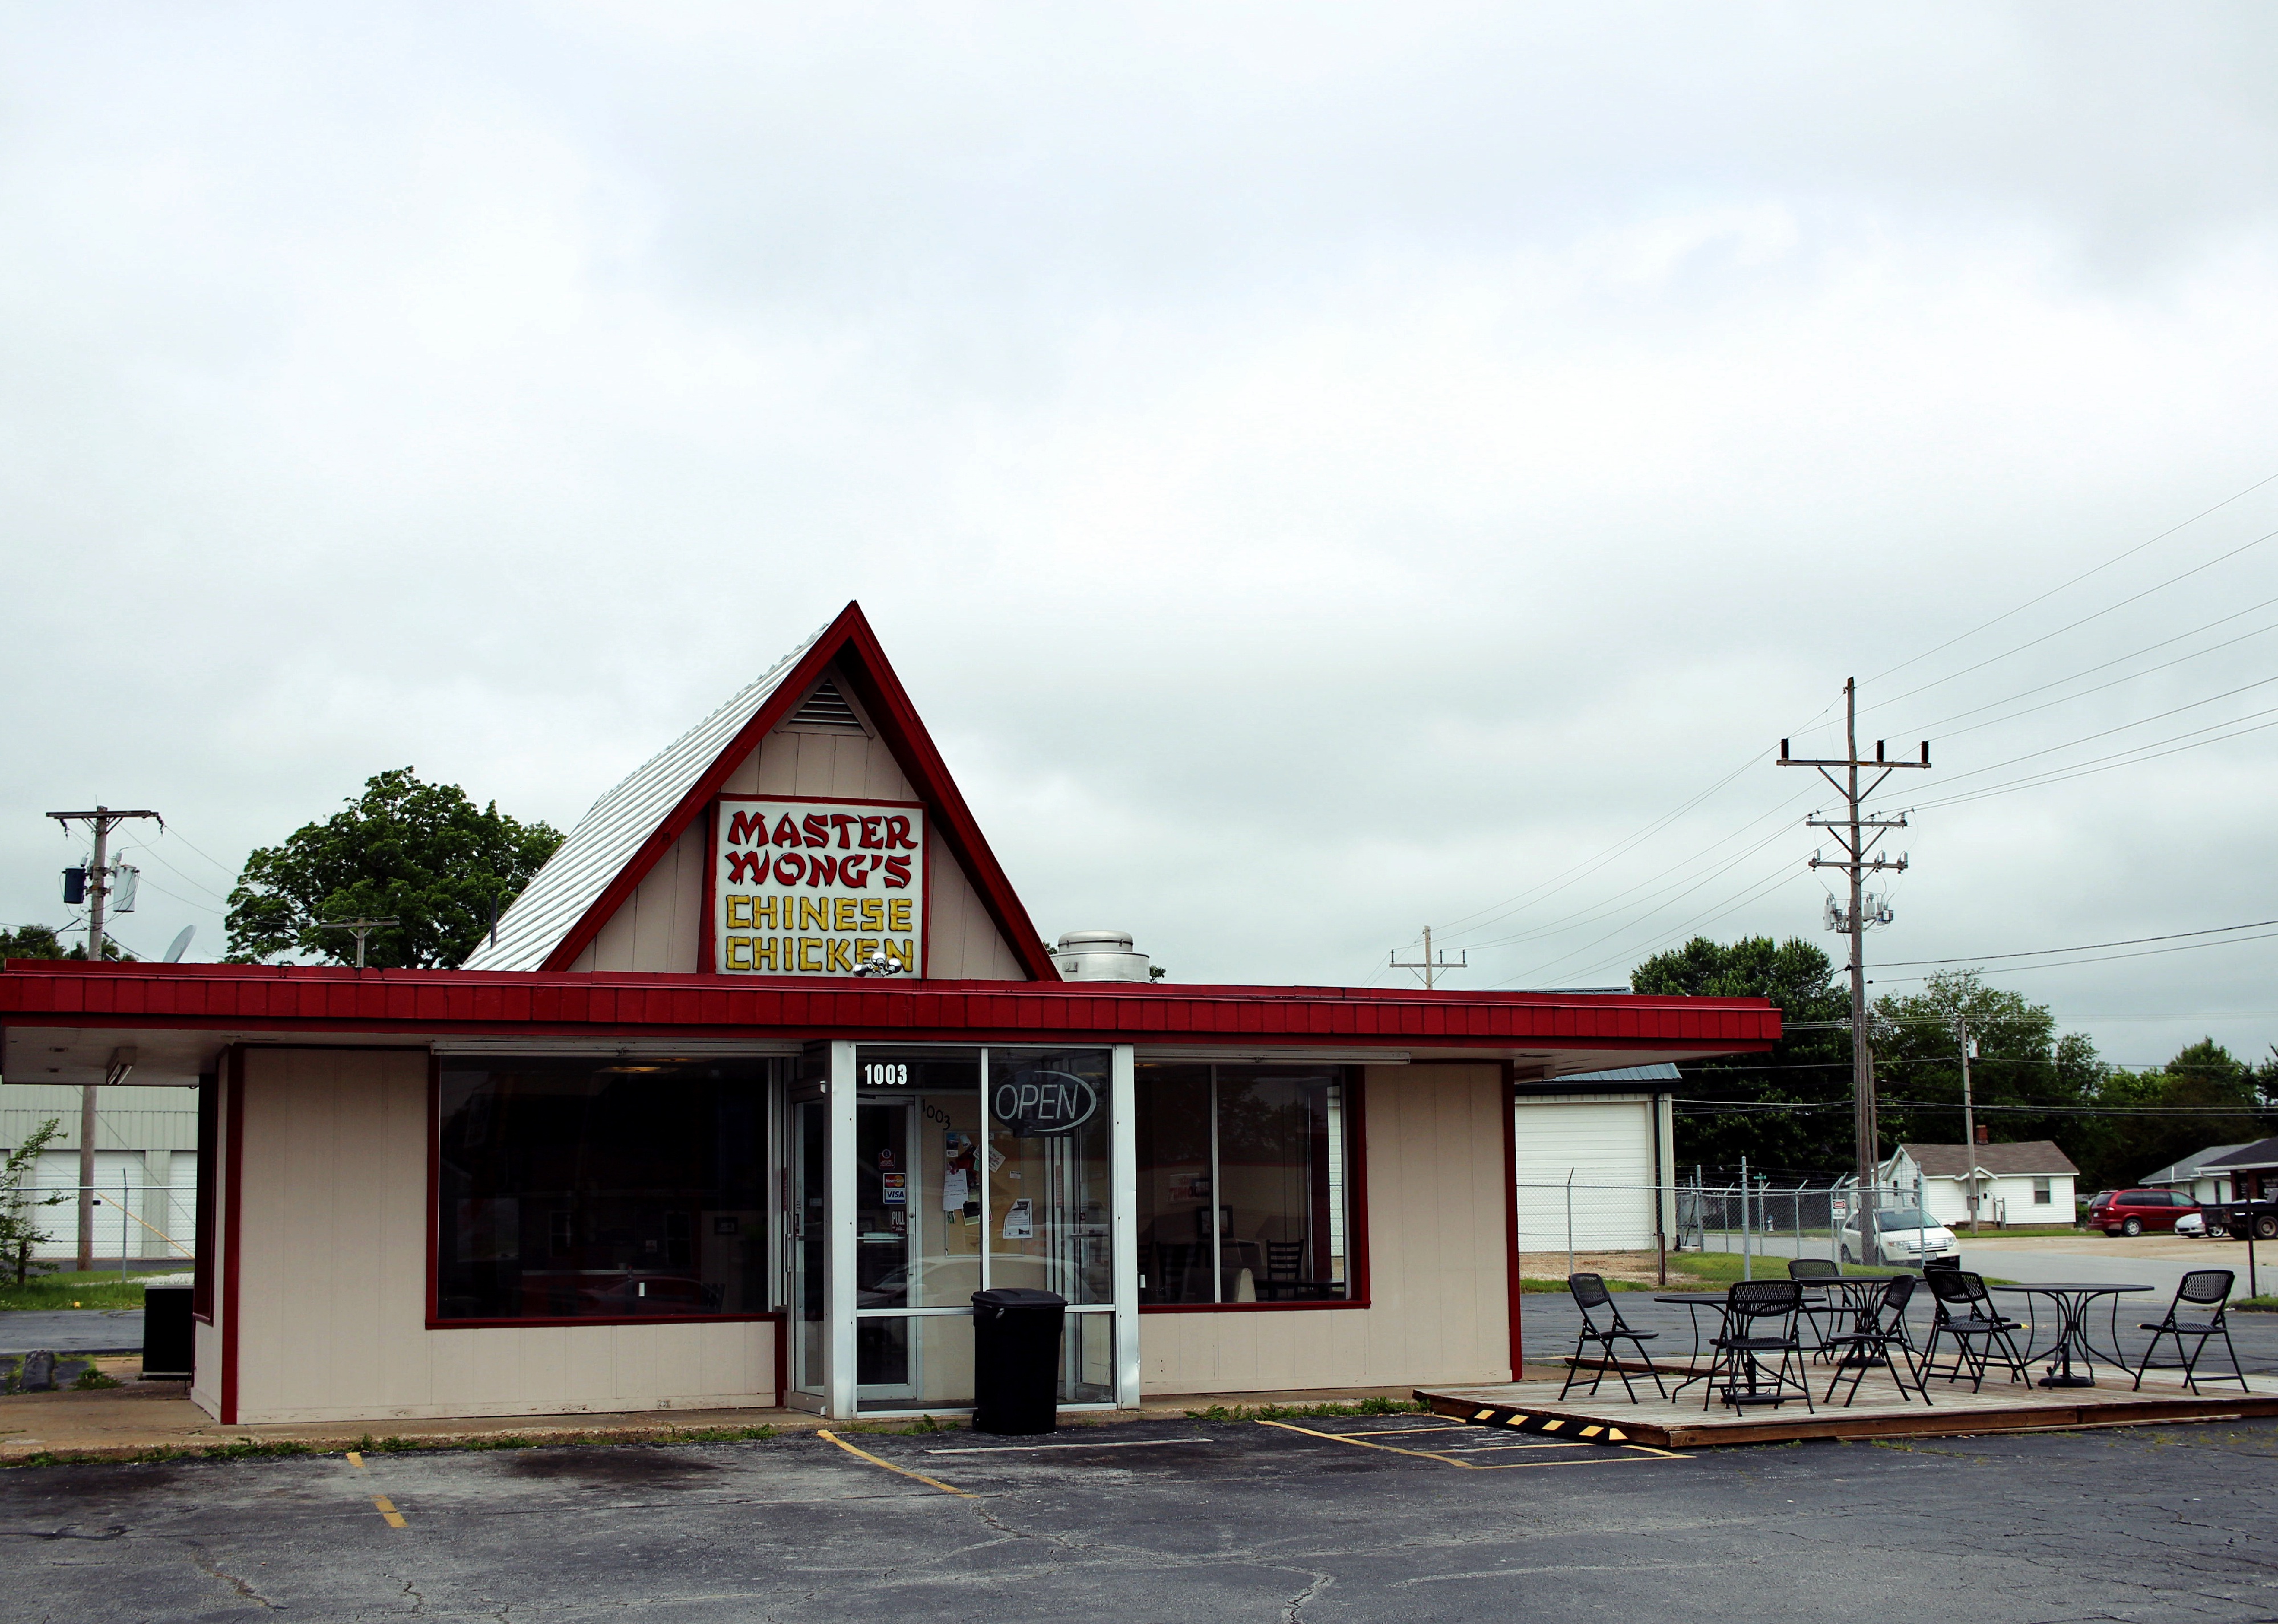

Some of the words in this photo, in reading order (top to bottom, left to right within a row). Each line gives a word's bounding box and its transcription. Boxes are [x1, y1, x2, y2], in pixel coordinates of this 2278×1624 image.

[727, 810, 918, 850] MASTER
[725, 849, 911, 889] WONG'S
[726, 895, 912, 932] CHINESE
[726, 936, 914, 972] CHICKEN
[865, 1064, 907, 1084] 1003
[922, 1099, 951, 1131] 1003
[996, 1084, 1078, 1120] OPEN
[891, 1211, 905, 1225] PULL
